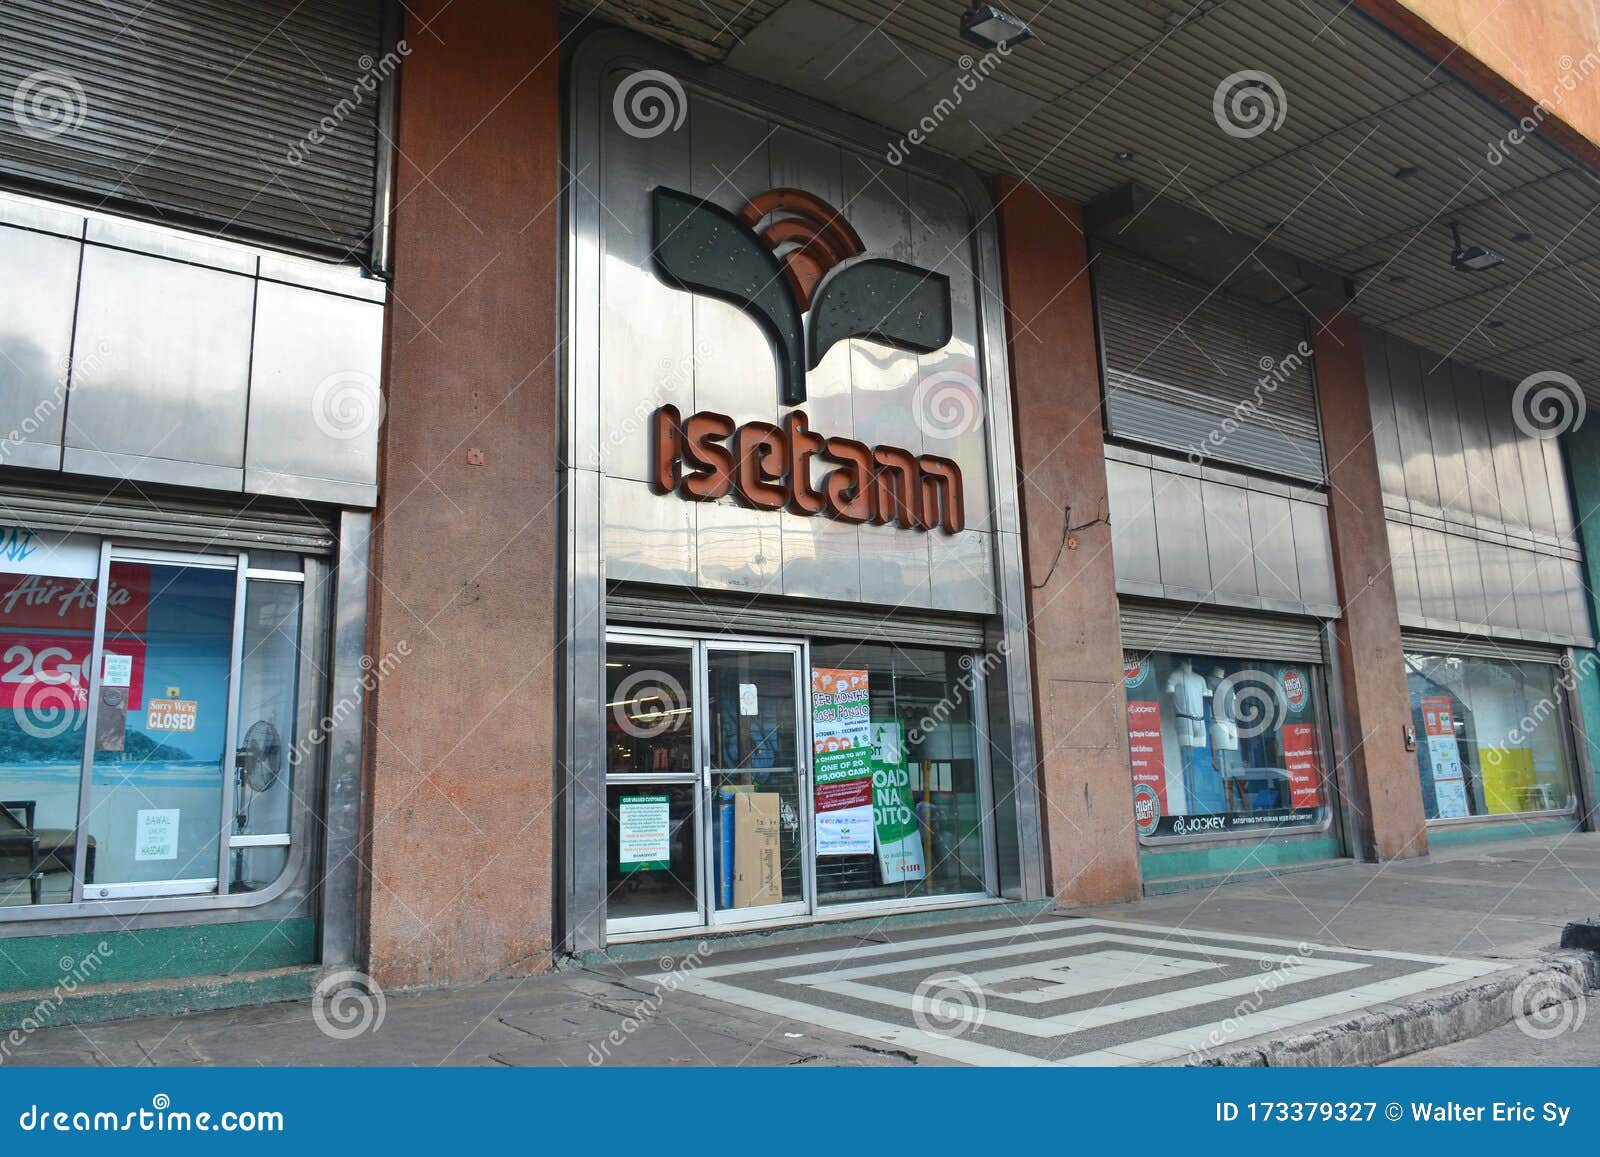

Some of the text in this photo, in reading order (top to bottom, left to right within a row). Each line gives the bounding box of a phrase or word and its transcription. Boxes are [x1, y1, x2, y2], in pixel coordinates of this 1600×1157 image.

[648, 403, 965, 536] Isetann
[151, 703, 171, 713] Sorry
[149, 712, 195, 730] CLOSED
[821, 764, 838, 772] ONE
[848, 766, 870, 776] CASH
[872, 769, 908, 788] OAD
[877, 788, 900, 806] NA
[1135, 800, 1153, 812] HIGH
[1186, 816, 1225, 831] JOCKEY
